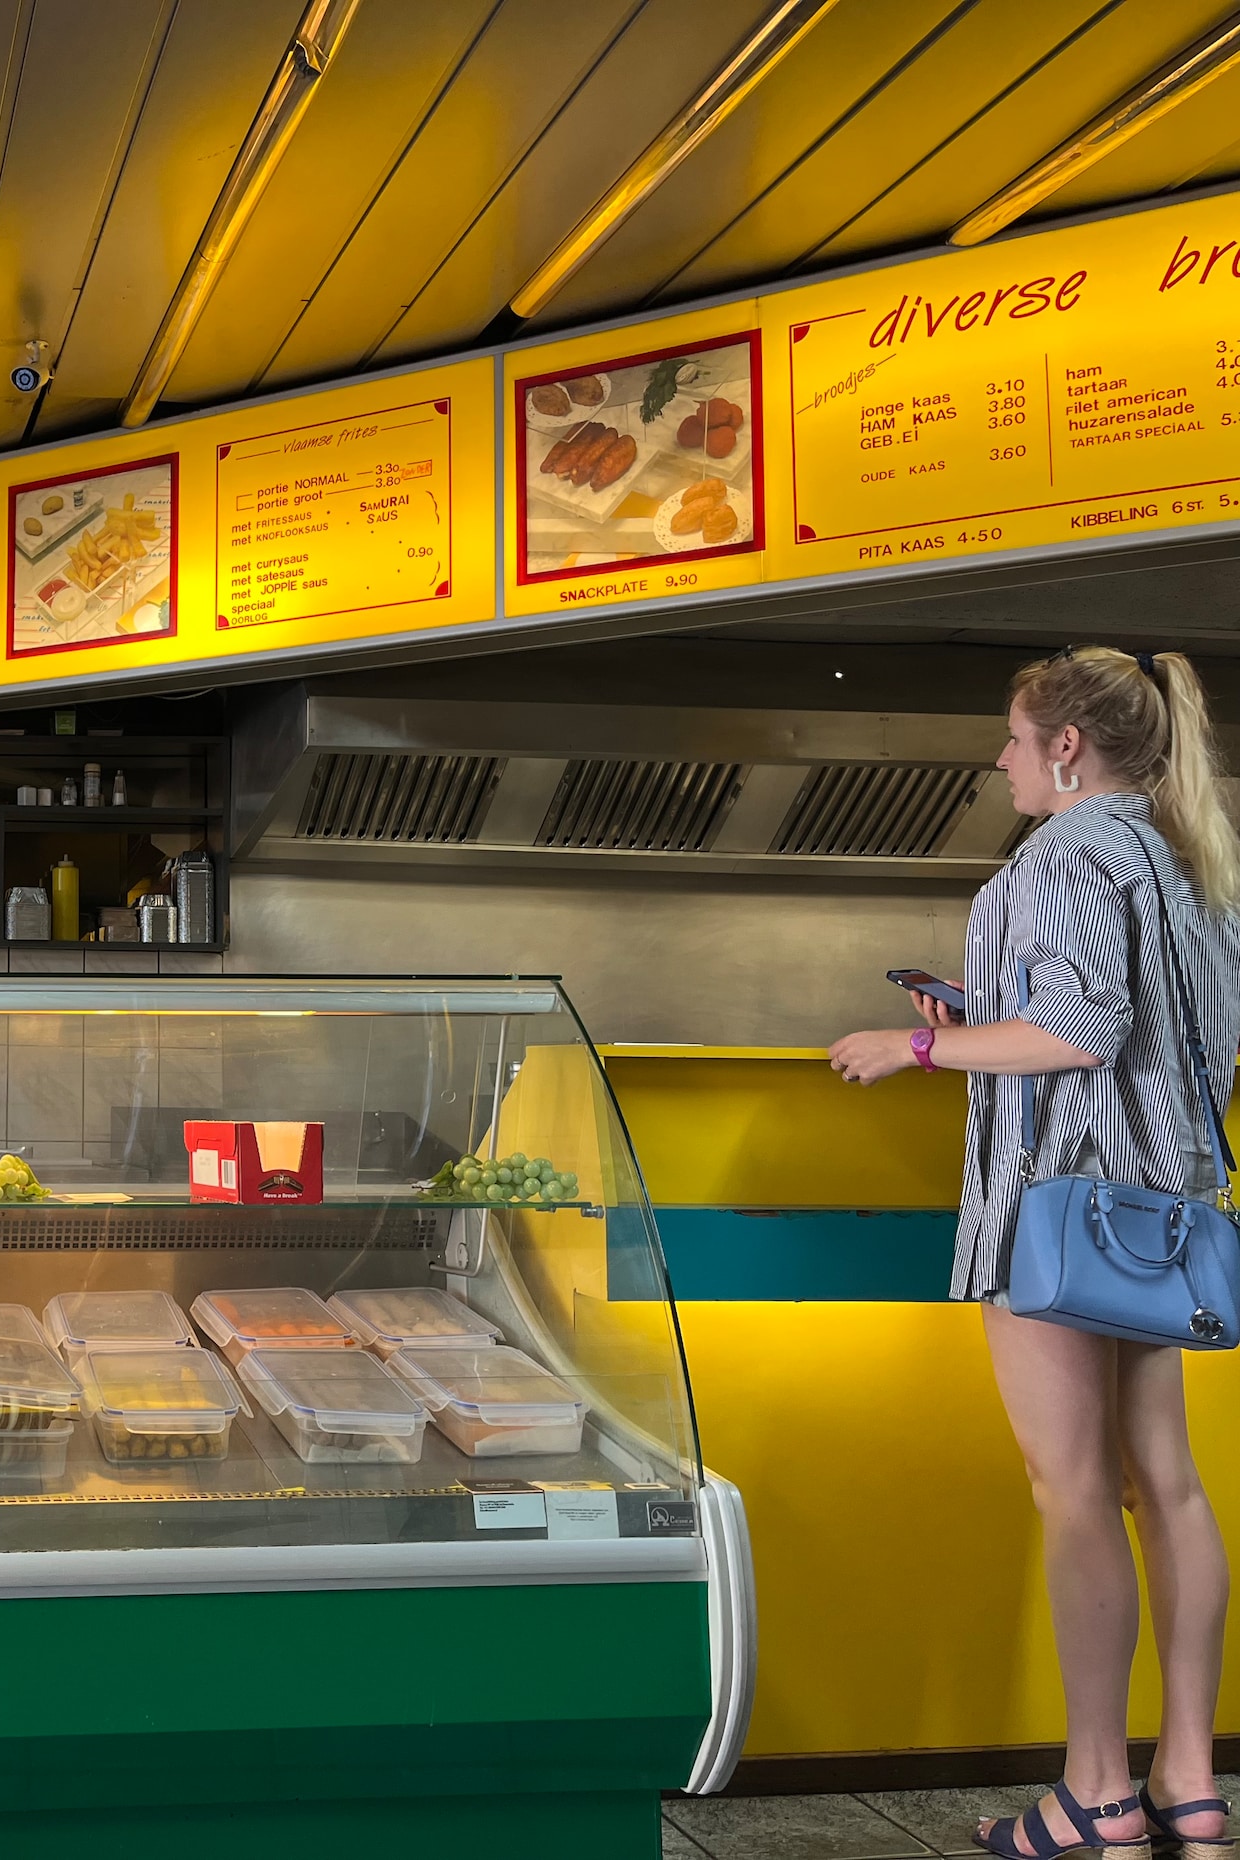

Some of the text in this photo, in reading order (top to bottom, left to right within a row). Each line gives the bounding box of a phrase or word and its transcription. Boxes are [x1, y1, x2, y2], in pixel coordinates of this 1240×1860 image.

[869, 270, 1088, 349] diverse
[813, 362, 877, 409] broodjes
[1065, 366, 1103, 381] ham
[860, 379, 1025, 420] jonge kaas 3.10
[1107, 387, 1188, 408] american
[860, 395, 1026, 434] HAM KAAS 3.80
[987, 412, 1026, 429] 3.60
[1068, 402, 1195, 431] huzarensalade
[282, 424, 379, 454] vlaamse frites
[1070, 431, 1131, 448] TARTAAR
[860, 444, 1027, 483] OUDE KAAS 3.60
[256, 462, 400, 499] portie NORMAAL 3.30
[256, 476, 401, 513] portie groot 3.80
[1070, 503, 1159, 528] KIBBELING
[1172, 500, 1183, 514] 6
[231, 522, 252, 534] met
[231, 522, 329, 547] met KNOFLOOKSAUS
[406, 547, 434, 559] 0.90
[858, 527, 1003, 560] PITA KAAS 4.50
[231, 553, 309, 574] met currysaus
[231, 567, 305, 588] met satesaus
[231, 577, 328, 601] met JOPPIE saus
[559, 573, 698, 603] SNACKPLATE 9.90
[231, 598, 276, 615] speciaal
[231, 612, 268, 625] OORLOG
